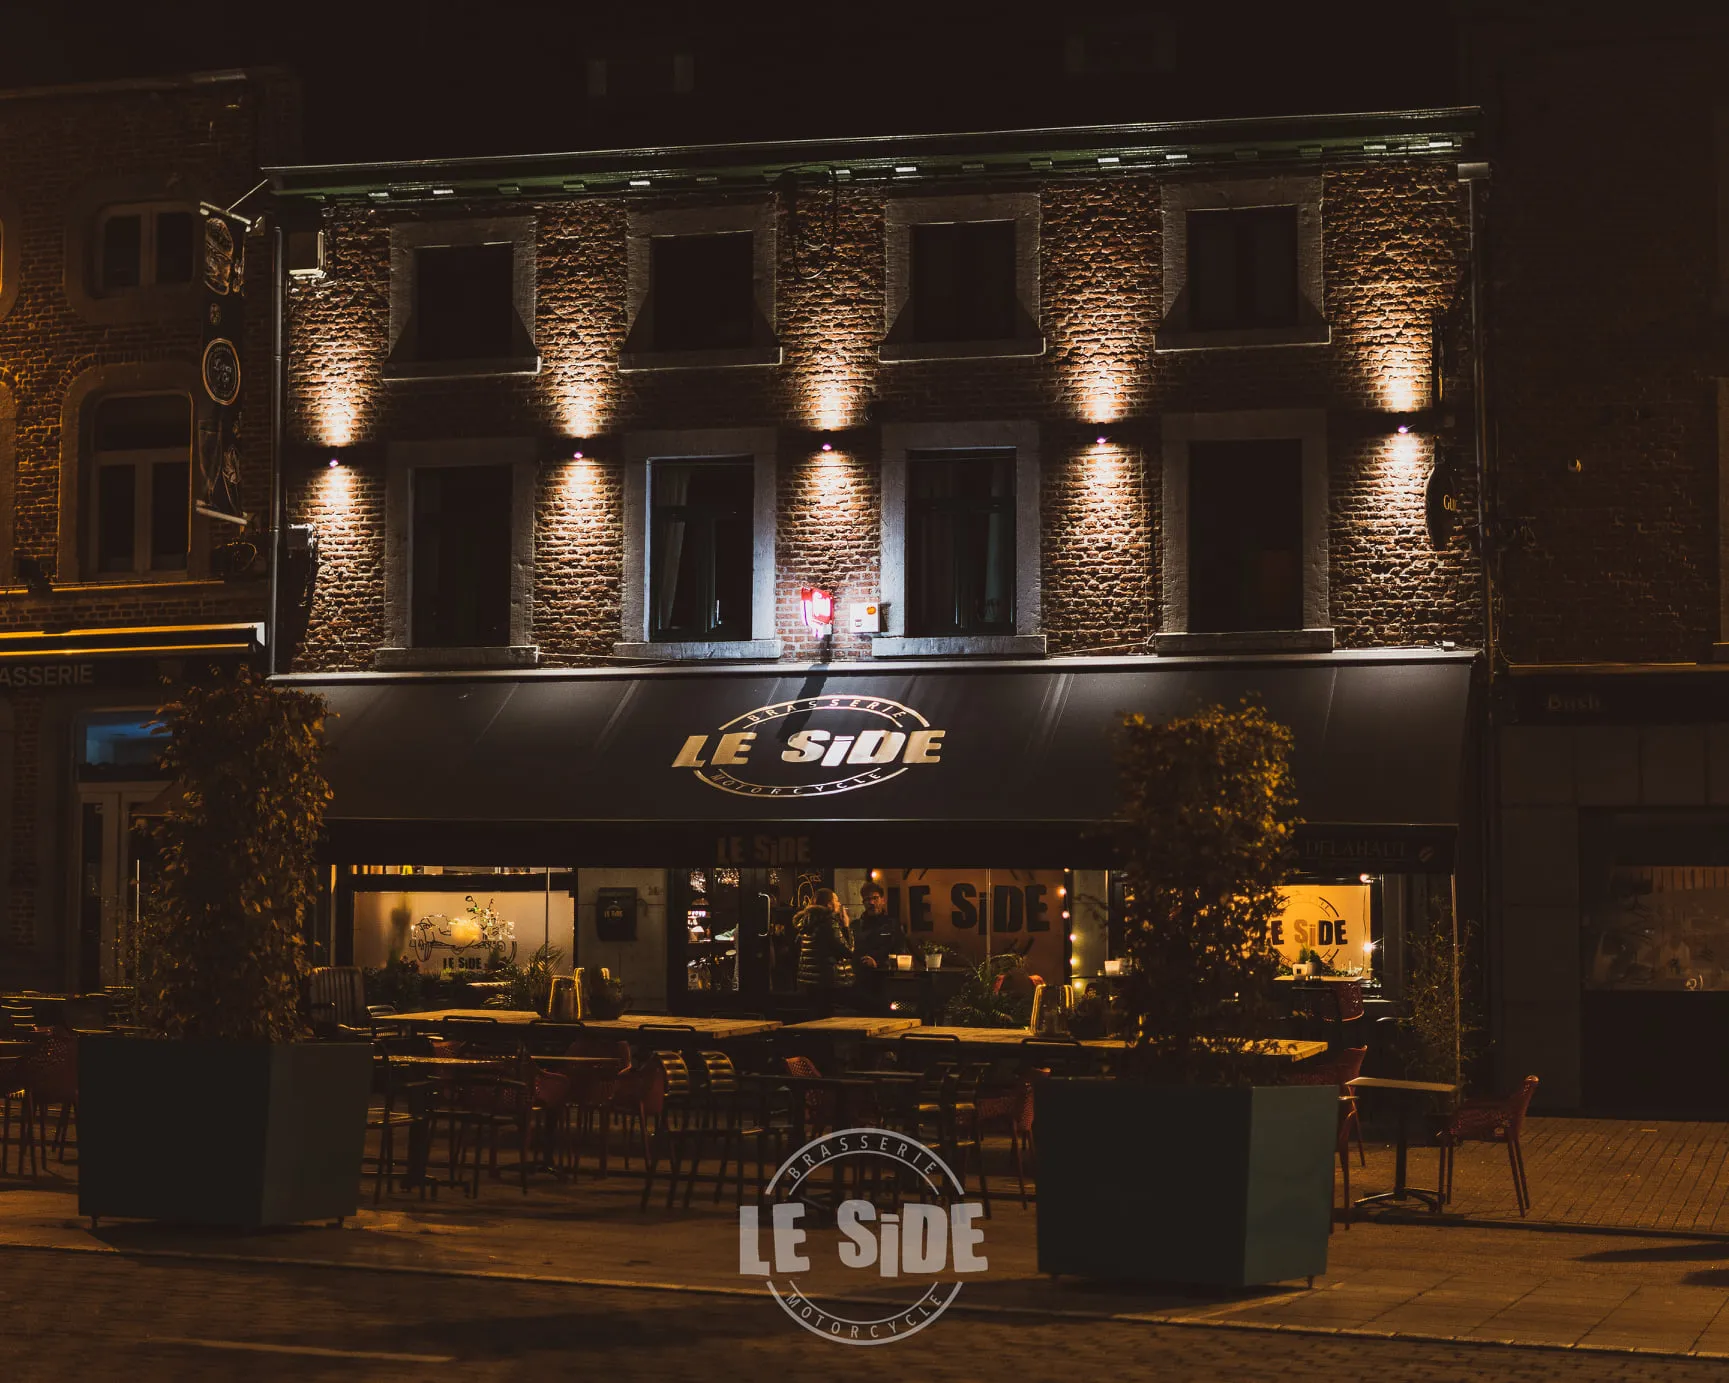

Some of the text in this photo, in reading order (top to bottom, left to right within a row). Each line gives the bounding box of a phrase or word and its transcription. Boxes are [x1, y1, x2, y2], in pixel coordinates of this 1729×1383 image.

[747, 698, 908, 722] BRASSERIE
[672, 731, 757, 767] LE
[710, 773, 882, 795] MOTORCYCLE
[717, 836, 744, 864] LE
